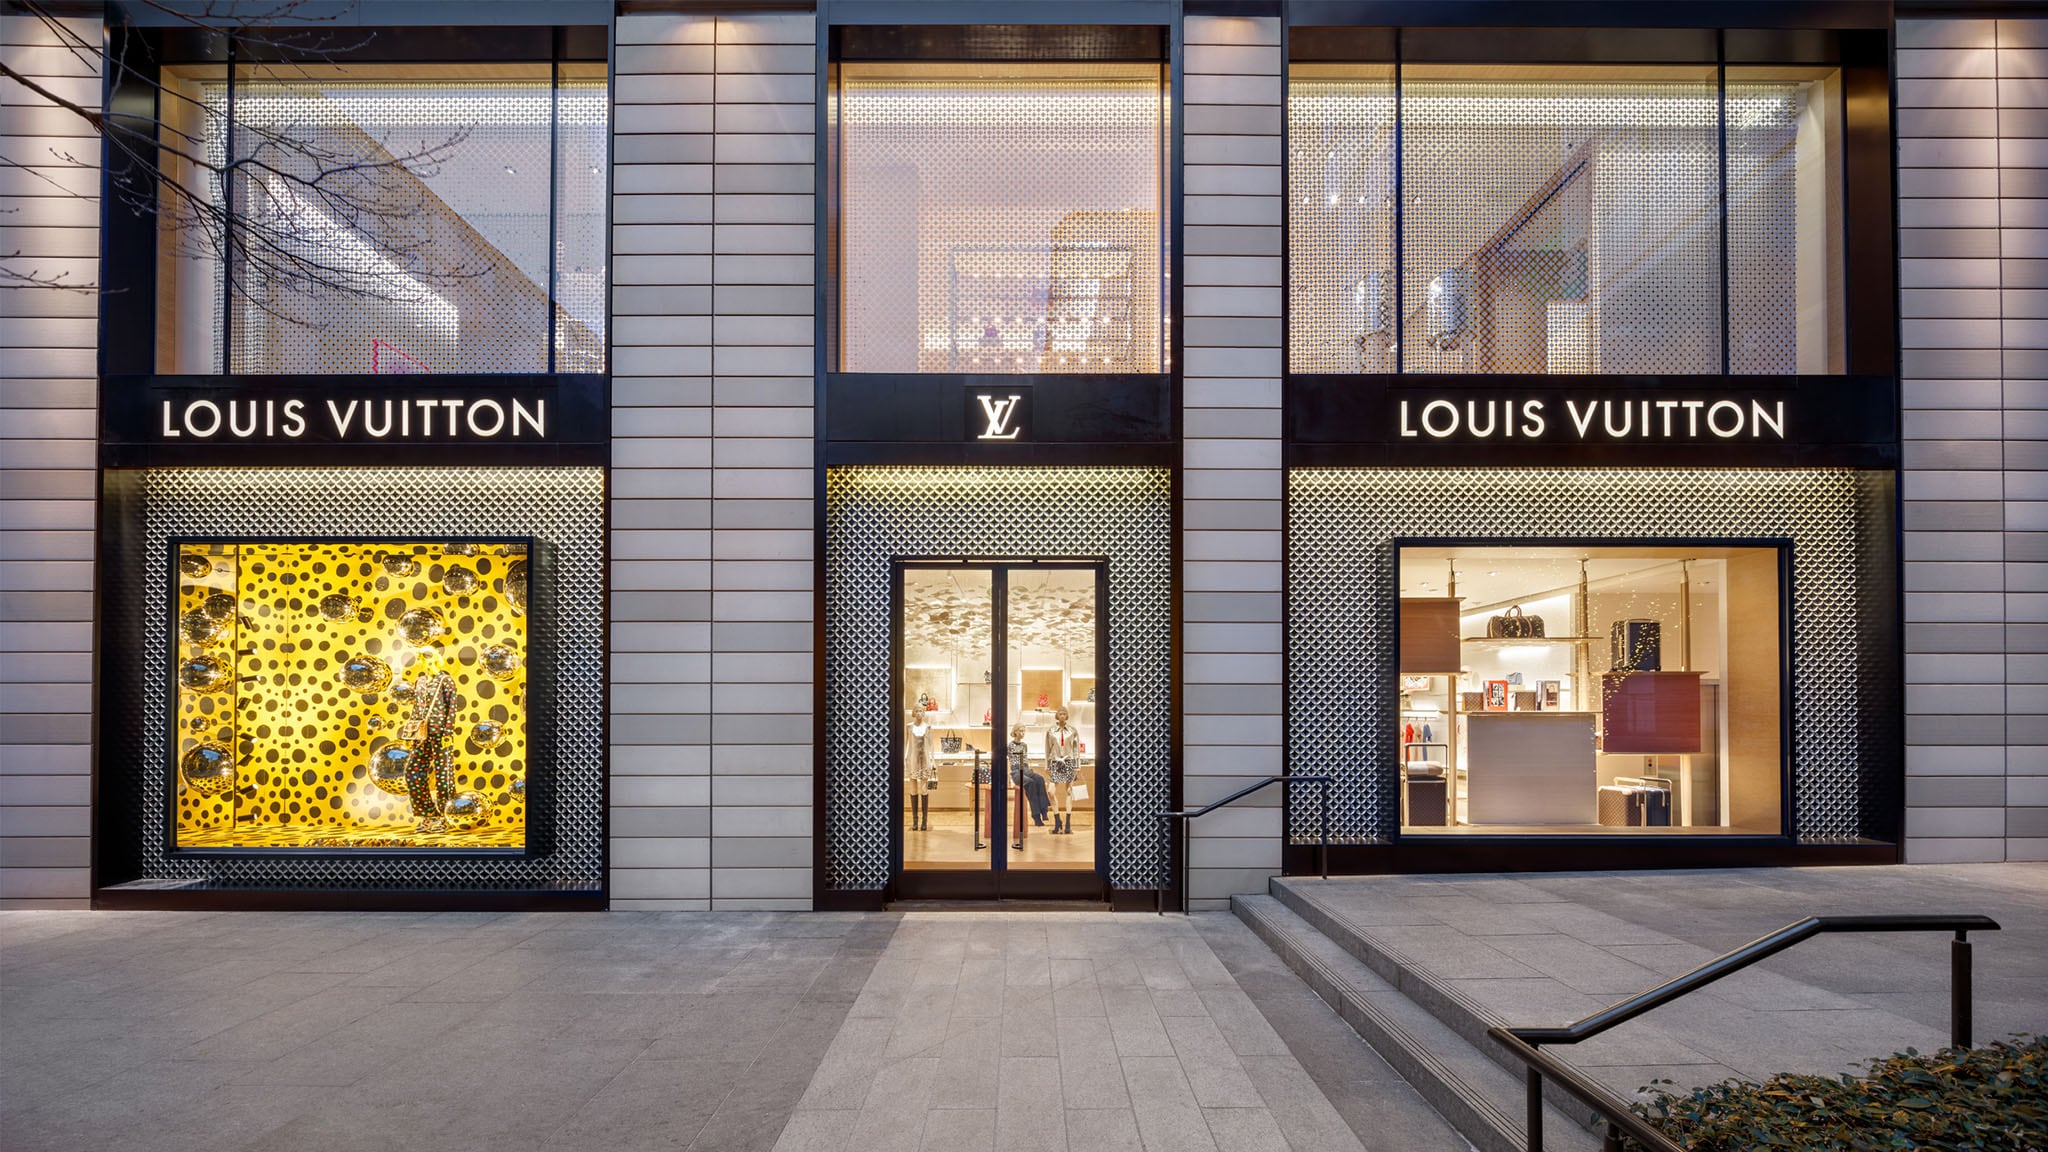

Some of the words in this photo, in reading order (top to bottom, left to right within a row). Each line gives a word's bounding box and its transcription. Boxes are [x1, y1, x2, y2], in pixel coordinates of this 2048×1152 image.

[163, 400, 306, 437] LOUIS
[327, 399, 545, 438] VUITTON
[1400, 400, 1545, 438] LOUIS
[1567, 400, 1784, 438] VUITTON
